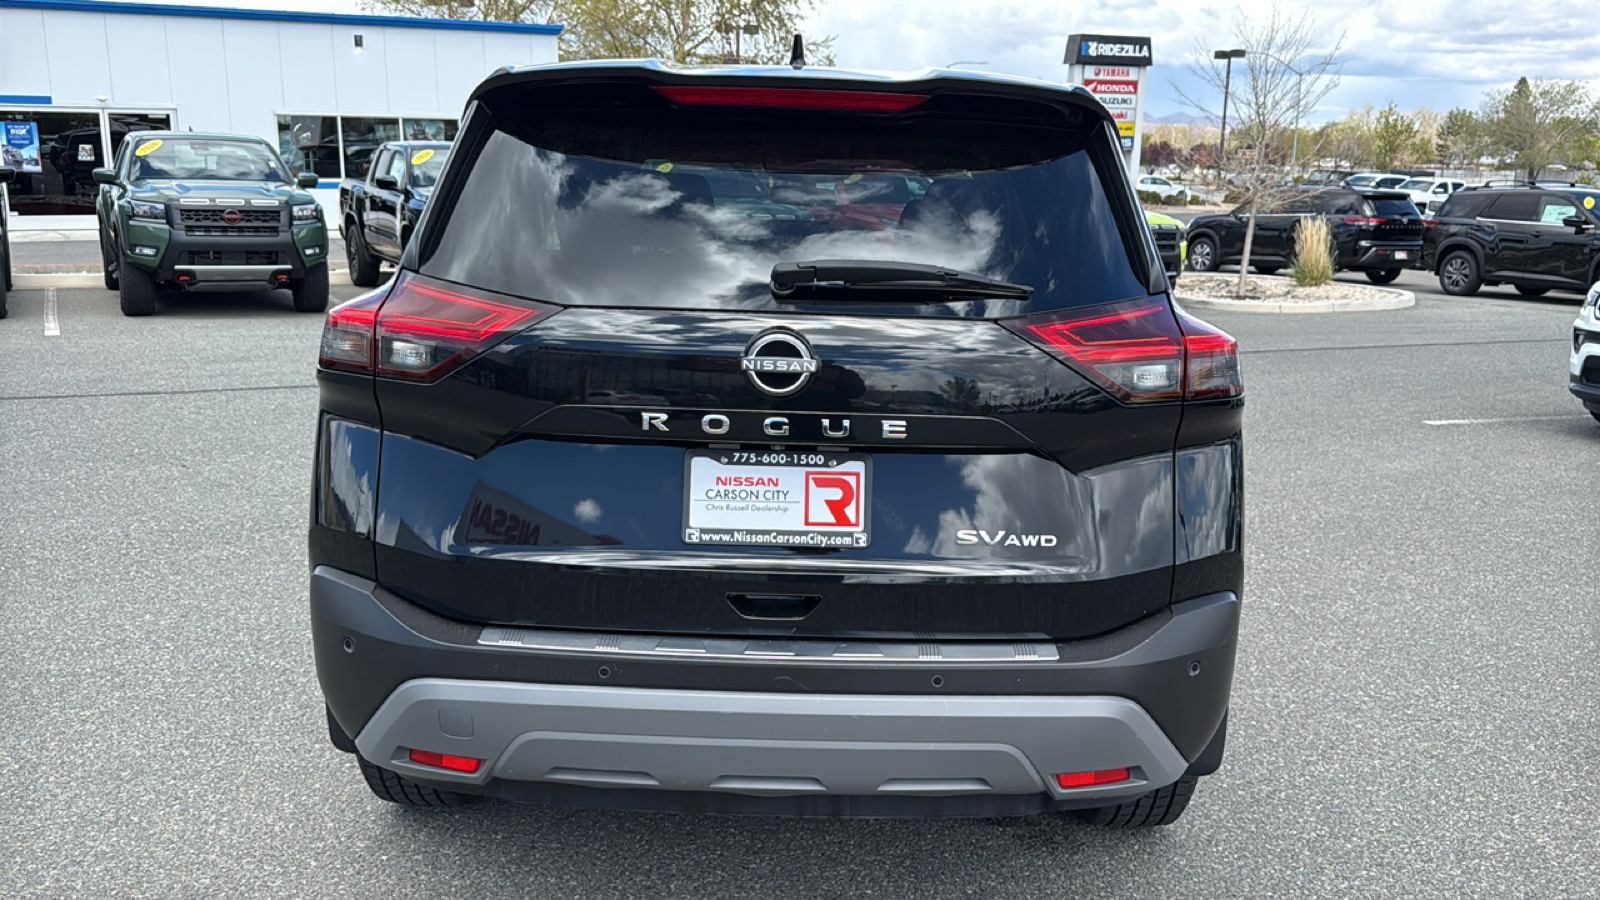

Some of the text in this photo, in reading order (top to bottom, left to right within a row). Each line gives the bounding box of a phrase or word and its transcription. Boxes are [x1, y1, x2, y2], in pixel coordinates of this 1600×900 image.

[1097, 43, 1149, 58] RIDEZILLA
[1102, 68, 1130, 77] YAMAHA
[1096, 84, 1135, 92] HONDA
[1099, 97, 1132, 105] SUZUKI
[742, 359, 817, 372] NISSAN
[641, 411, 908, 439] ROGUE
[733, 453, 825, 465] 775-600-1500
[715, 476, 780, 487] NISSAN
[705, 488, 790, 501] CARSON CITY
[705, 503, 789, 514] Chris Russell Dealership
[701, 531, 852, 546] www.NissanCarsonCity.com
[956, 529, 1057, 547] SV AWD
